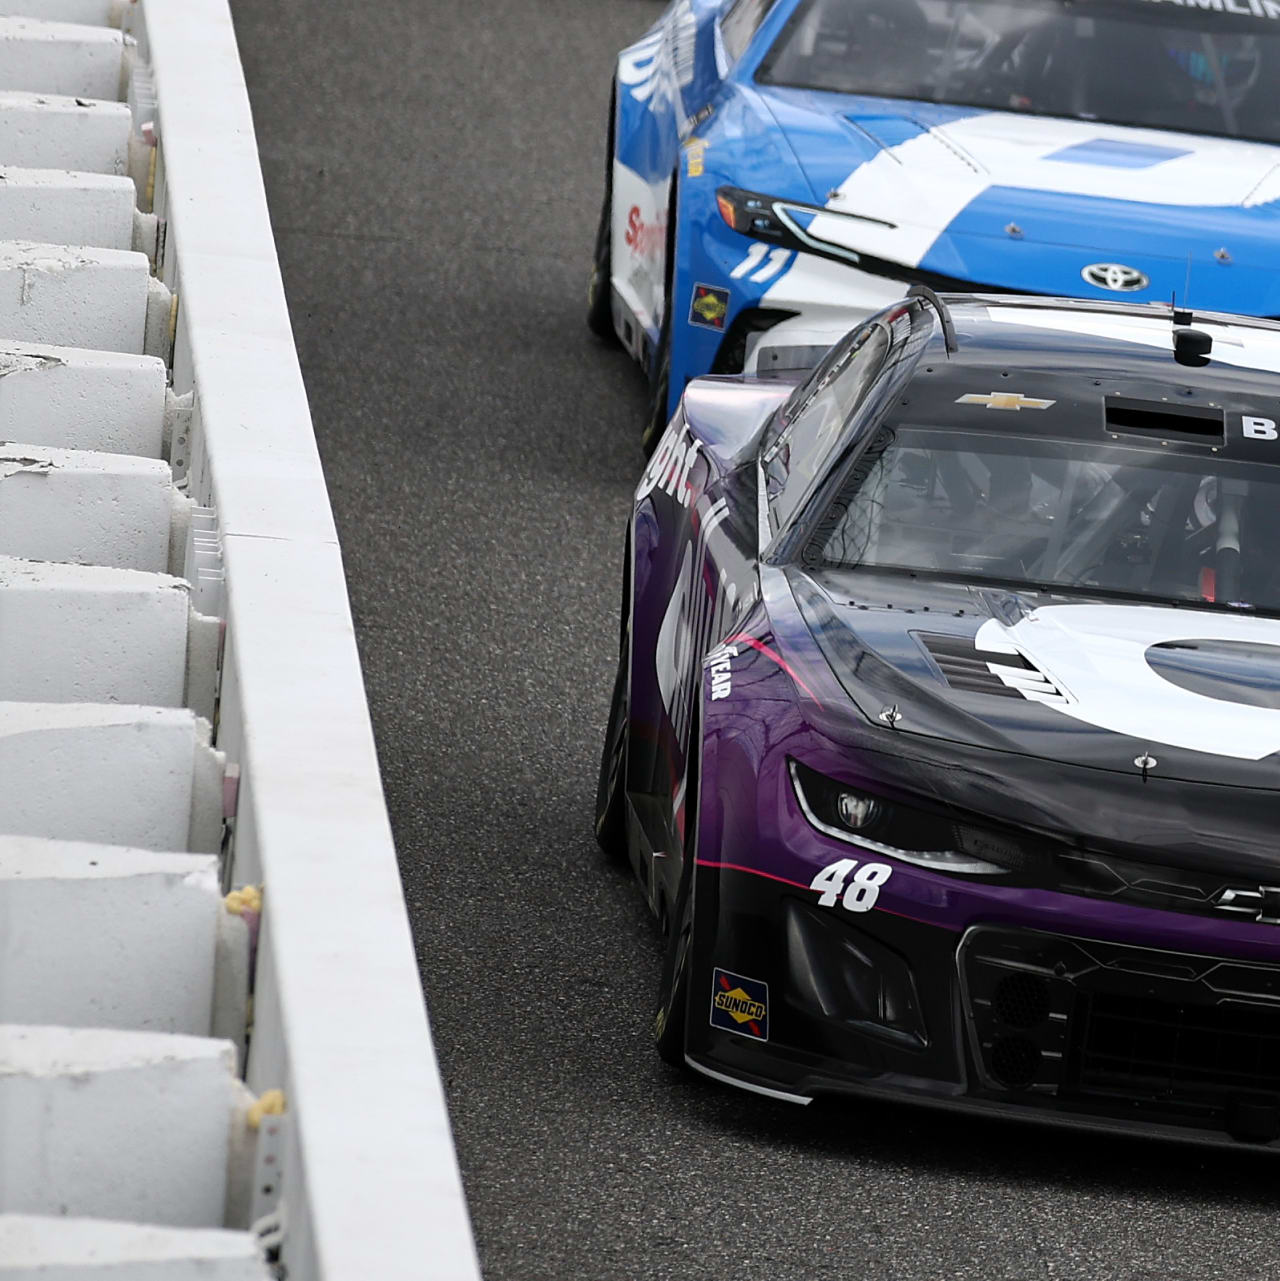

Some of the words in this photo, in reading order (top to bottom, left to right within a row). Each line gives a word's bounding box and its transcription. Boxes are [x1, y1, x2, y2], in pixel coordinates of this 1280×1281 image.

[729, 241, 793, 284] 11
[809, 858, 893, 913] 48
[715, 992, 765, 1020] SUNOCO
